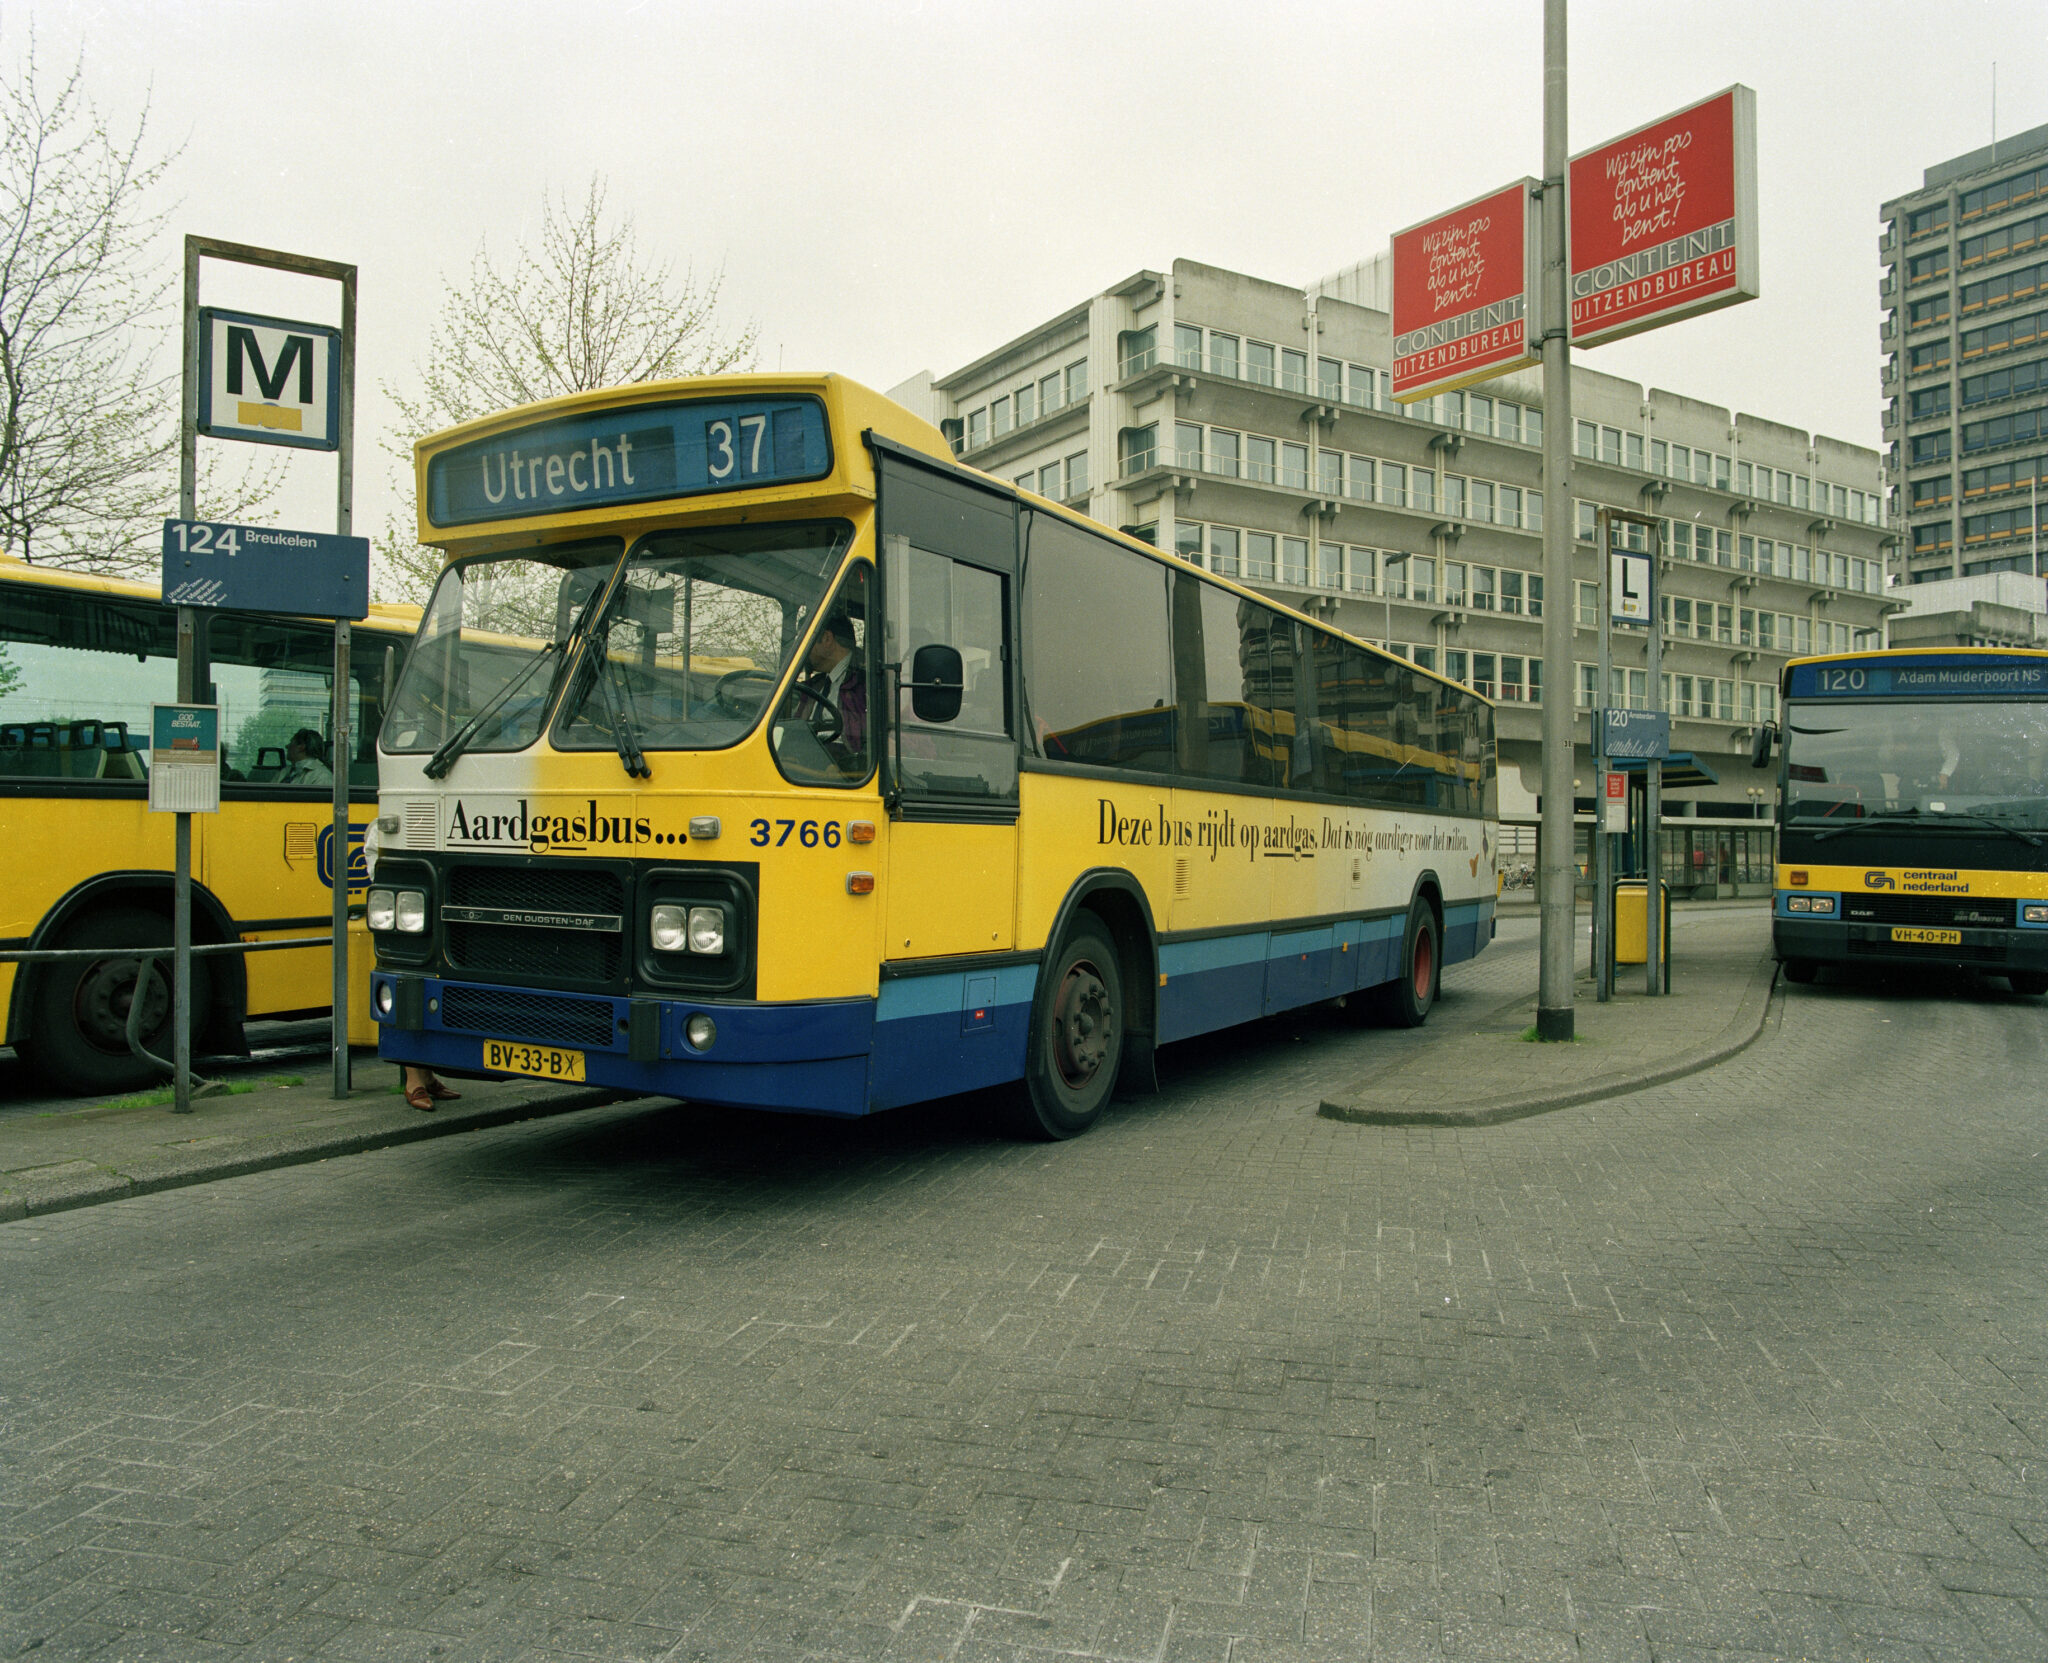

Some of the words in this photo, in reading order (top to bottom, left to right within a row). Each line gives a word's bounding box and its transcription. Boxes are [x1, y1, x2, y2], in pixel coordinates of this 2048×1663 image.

[1630, 143, 1662, 174] zijn
[1663, 131, 1692, 164] pas
[1613, 195, 1636, 220] als
[1640, 195, 1650, 211] u
[1655, 176, 1685, 206] het
[1616, 157, 1679, 200] content
[1467, 216, 1490, 244] pas
[1622, 199, 1681, 246] bent!
[1428, 268, 1446, 290] als
[1449, 270, 1457, 283] u
[1461, 255, 1485, 277] het
[1430, 237, 1480, 272] content
[1574, 223, 1730, 296] CONTENT
[1435, 275, 1481, 312] bent!
[1574, 252, 1732, 320] UITZENDBUREAU
[1396, 298, 1520, 356] CONTENT
[227, 325, 313, 404] M
[1395, 323, 1521, 377] UITZENDBUREAU
[482, 434, 635, 504] Utrecht
[709, 415, 766, 478] 37
[172, 524, 241, 556] 124
[245, 530, 317, 548] Breukelen
[1622, 558, 1638, 599] L
[1822, 669, 1864, 690] 120
[1939, 670, 2019, 683] Muiderpoort
[2023, 670, 2040, 681] NS
[1608, 710, 1628, 727] 120
[446, 800, 688, 853] Aardgasbus...
[750, 818, 842, 848] 3766
[1097, 799, 1152, 845] Deze
[1158, 804, 1192, 846] bus
[1198, 809, 1235, 862] rijdt
[1241, 824, 1259, 862] op
[1264, 815, 1317, 862] aardgas.
[1321, 817, 1342, 848] Dat
[1345, 820, 1353, 849] is
[1376, 823, 1413, 861] aardiger
[1433, 825, 1445, 850] het
[1903, 883, 1969, 893] nederland
[1904, 871, 1957, 880] centraal
[503, 914, 522, 922] DEN
[1894, 930, 1957, 942] VH-40-PH
[491, 1044, 575, 1076] BV-33-BX
